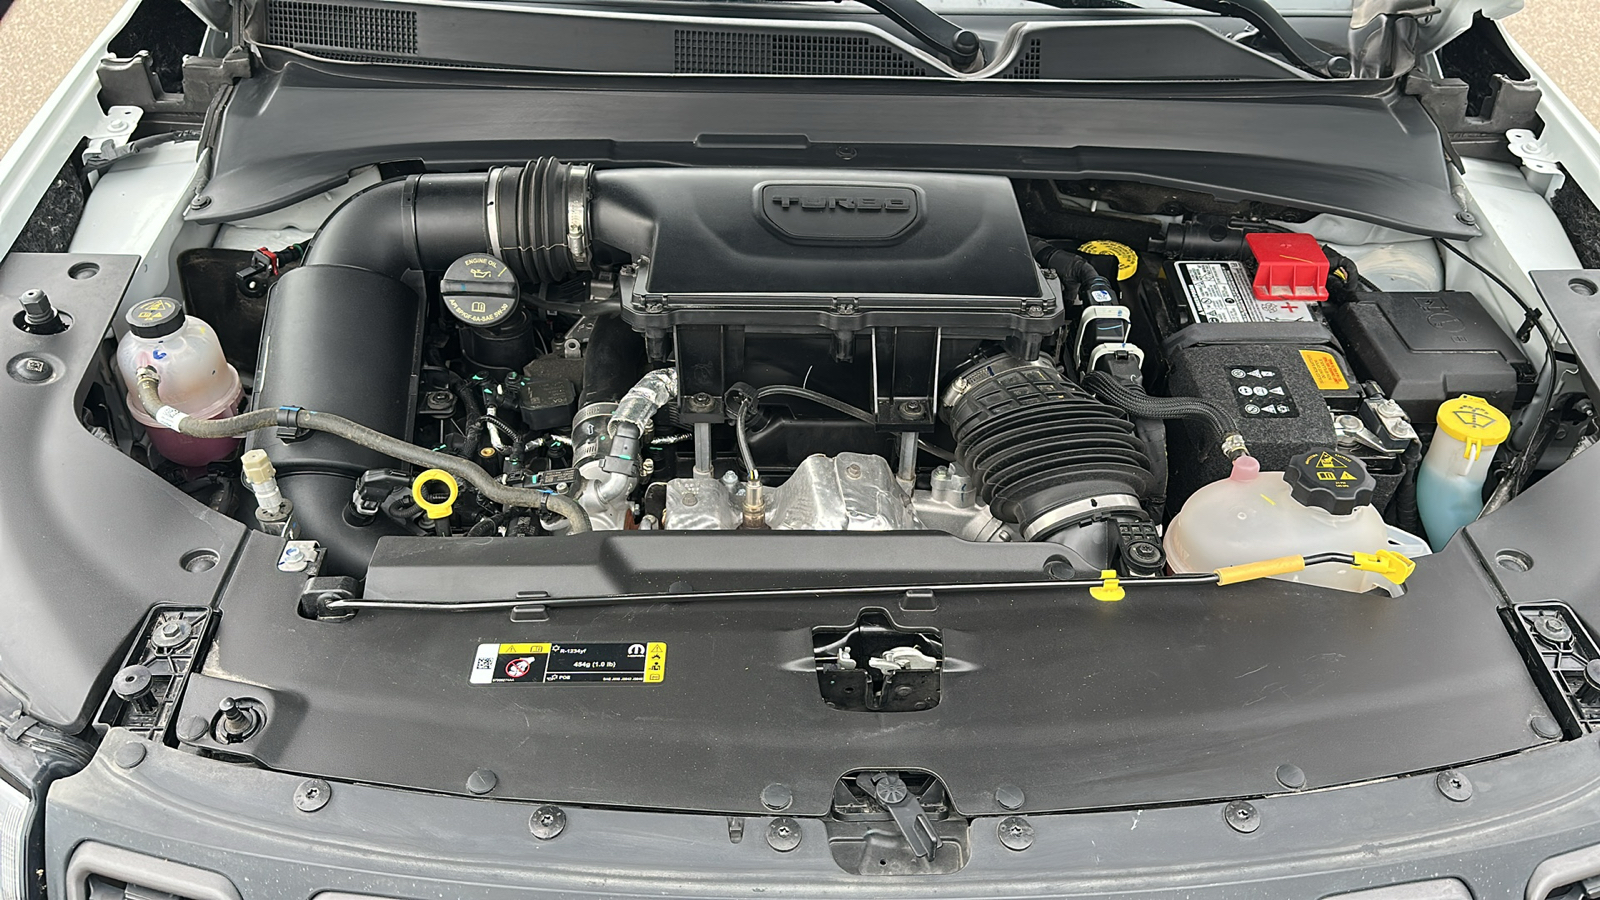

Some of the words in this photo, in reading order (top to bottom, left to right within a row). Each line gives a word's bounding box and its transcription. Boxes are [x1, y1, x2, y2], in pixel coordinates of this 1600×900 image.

[772, 196, 910, 210] TURBO
[464, 257, 488, 266] ENGINE
[487, 259, 498, 269] OIL
[449, 299, 458, 309] API
[493, 303, 509, 318] 5W-30
